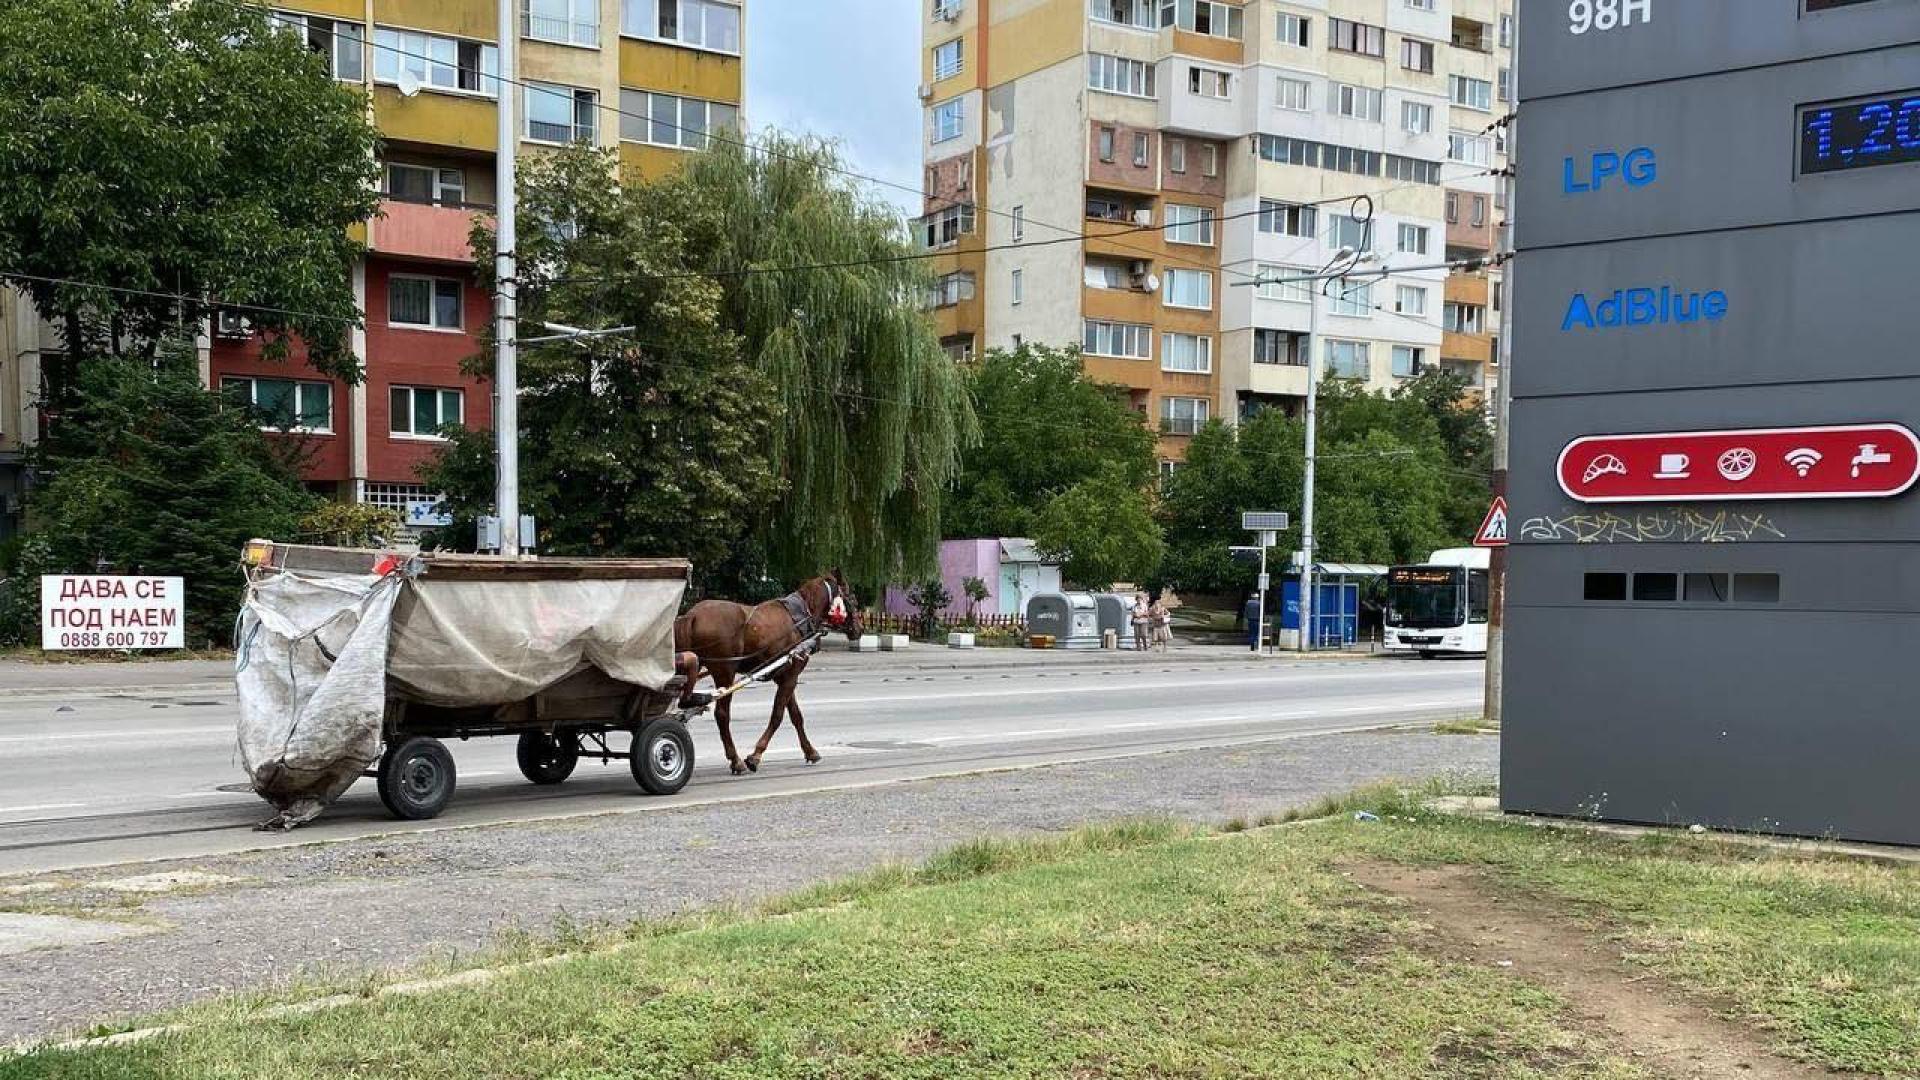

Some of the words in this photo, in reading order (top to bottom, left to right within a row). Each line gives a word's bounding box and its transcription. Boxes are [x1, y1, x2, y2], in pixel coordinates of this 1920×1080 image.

[1562, 147, 1656, 194] LPG
[1561, 286, 1728, 331] AdBlue
[60, 578, 127, 602] ДАВА
[135, 579, 166, 598] СЕ
[51, 608, 103, 630] ПОД
[111, 608, 176, 627] НАЕМ
[61, 632, 100, 647] 0888
[106, 632, 134, 647] 600
[141, 632, 168, 646] 797
